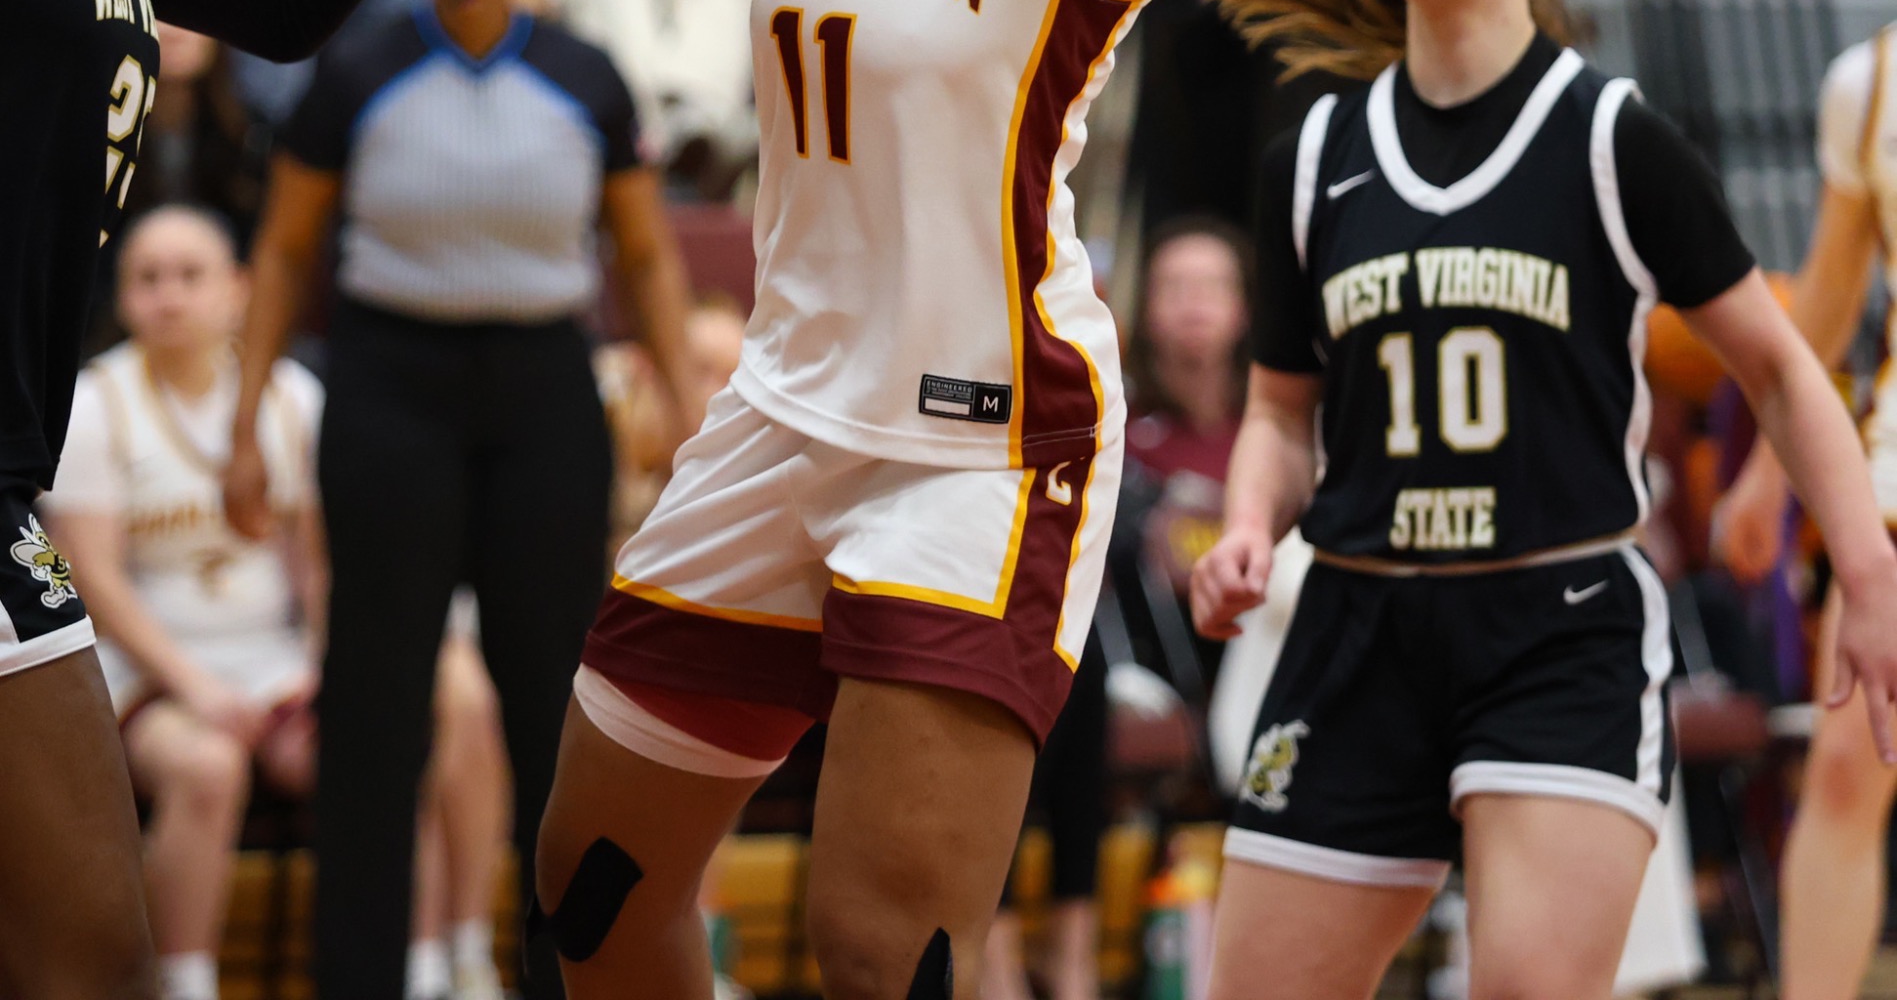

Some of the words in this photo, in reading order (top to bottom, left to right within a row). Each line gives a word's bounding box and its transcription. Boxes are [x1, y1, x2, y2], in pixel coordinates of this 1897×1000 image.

[769, 5, 858, 166] 11
[1321, 251, 1410, 341] WEST
[1414, 246, 1572, 333] VIRGINIA
[926, 379, 973, 393] ENGINEERED
[982, 395, 999, 413] M
[1376, 325, 1510, 458] 10
[1389, 485, 1497, 551] STATE
